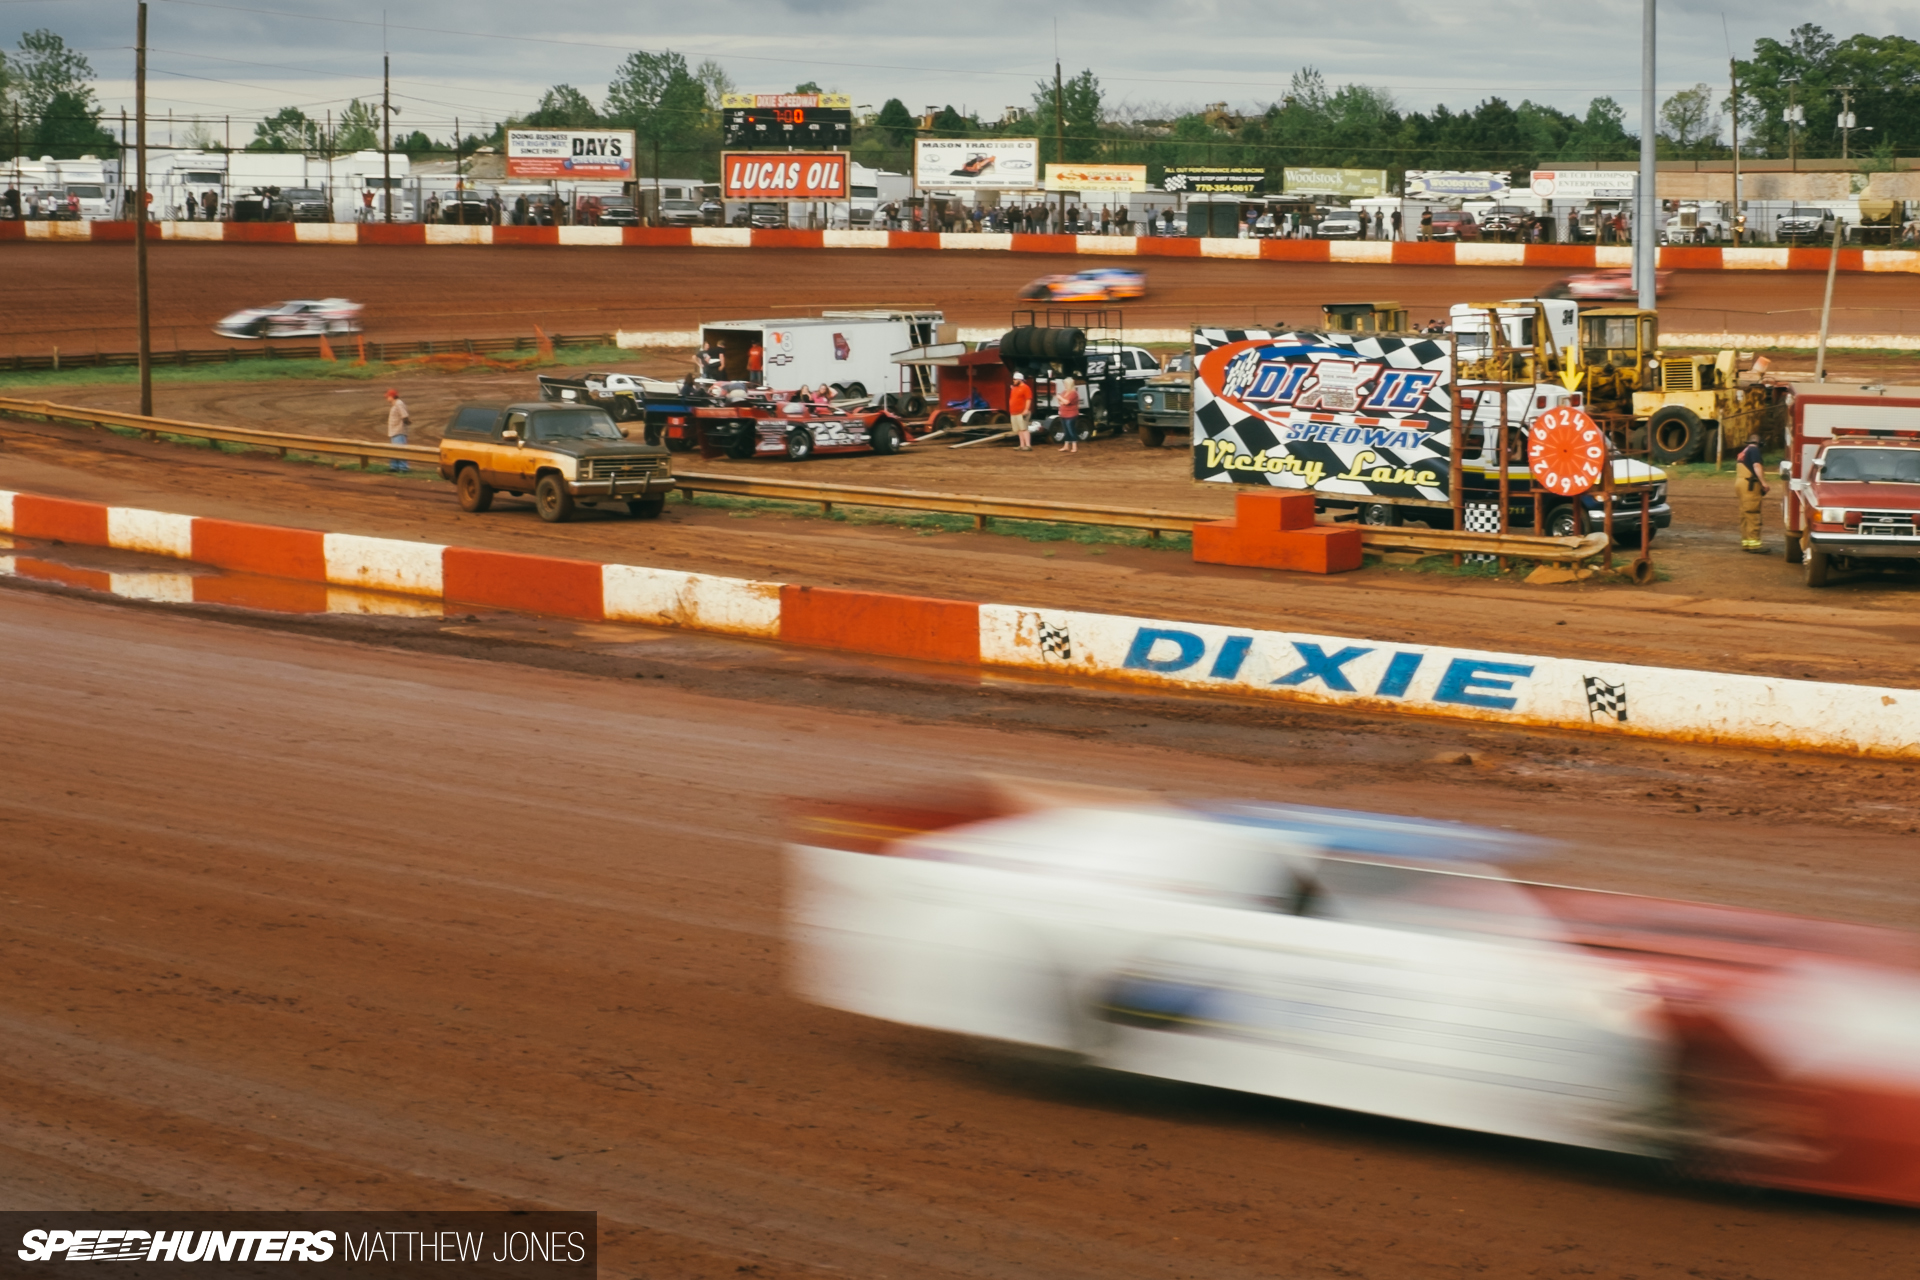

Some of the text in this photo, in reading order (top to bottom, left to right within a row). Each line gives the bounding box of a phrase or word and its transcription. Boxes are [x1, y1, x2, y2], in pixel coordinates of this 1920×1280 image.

[757, 95, 818, 107] DIXIE SPEEDWAY
[572, 135, 622, 157] DAY'S
[730, 162, 840, 190] LUCAS OIL
[1285, 170, 1344, 184] Woodstock
[1429, 179, 1490, 188] WOODSTOCK
[1087, 361, 1106, 374] 22
[1239, 359, 1442, 412] DIXIE
[807, 422, 848, 440] 22
[1286, 423, 1435, 449] SPEEDWAY
[1202, 439, 1441, 488] Victory Lane
[1124, 626, 1534, 711] DIXIE
